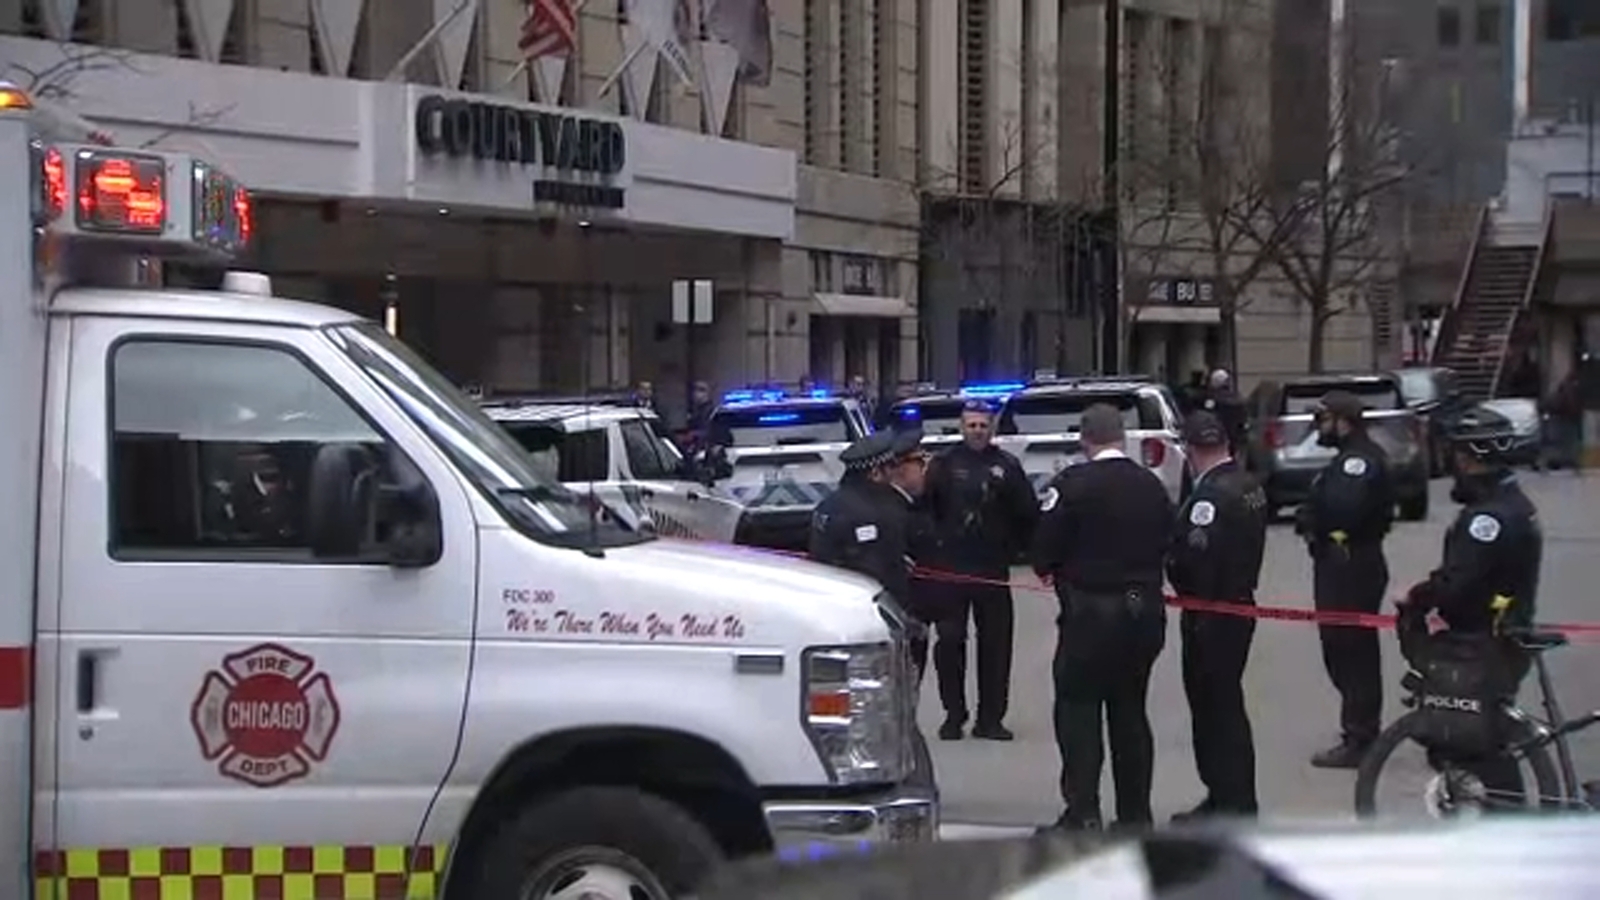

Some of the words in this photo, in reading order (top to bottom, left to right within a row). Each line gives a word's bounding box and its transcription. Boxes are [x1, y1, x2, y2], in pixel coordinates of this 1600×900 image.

[416, 95, 625, 174] COURTYARD
[503, 589, 529, 602] FDC
[506, 609, 548, 632] We're
[553, 610, 594, 633] There
[600, 612, 640, 634] When
[647, 613, 674, 640] You
[679, 614, 716, 637] Need
[722, 615, 745, 639] Us
[246, 657, 290, 672] FIRE
[1424, 696, 1481, 713] POLICE
[228, 701, 304, 729] CHICAGO
[240, 759, 288, 775] DEPT
